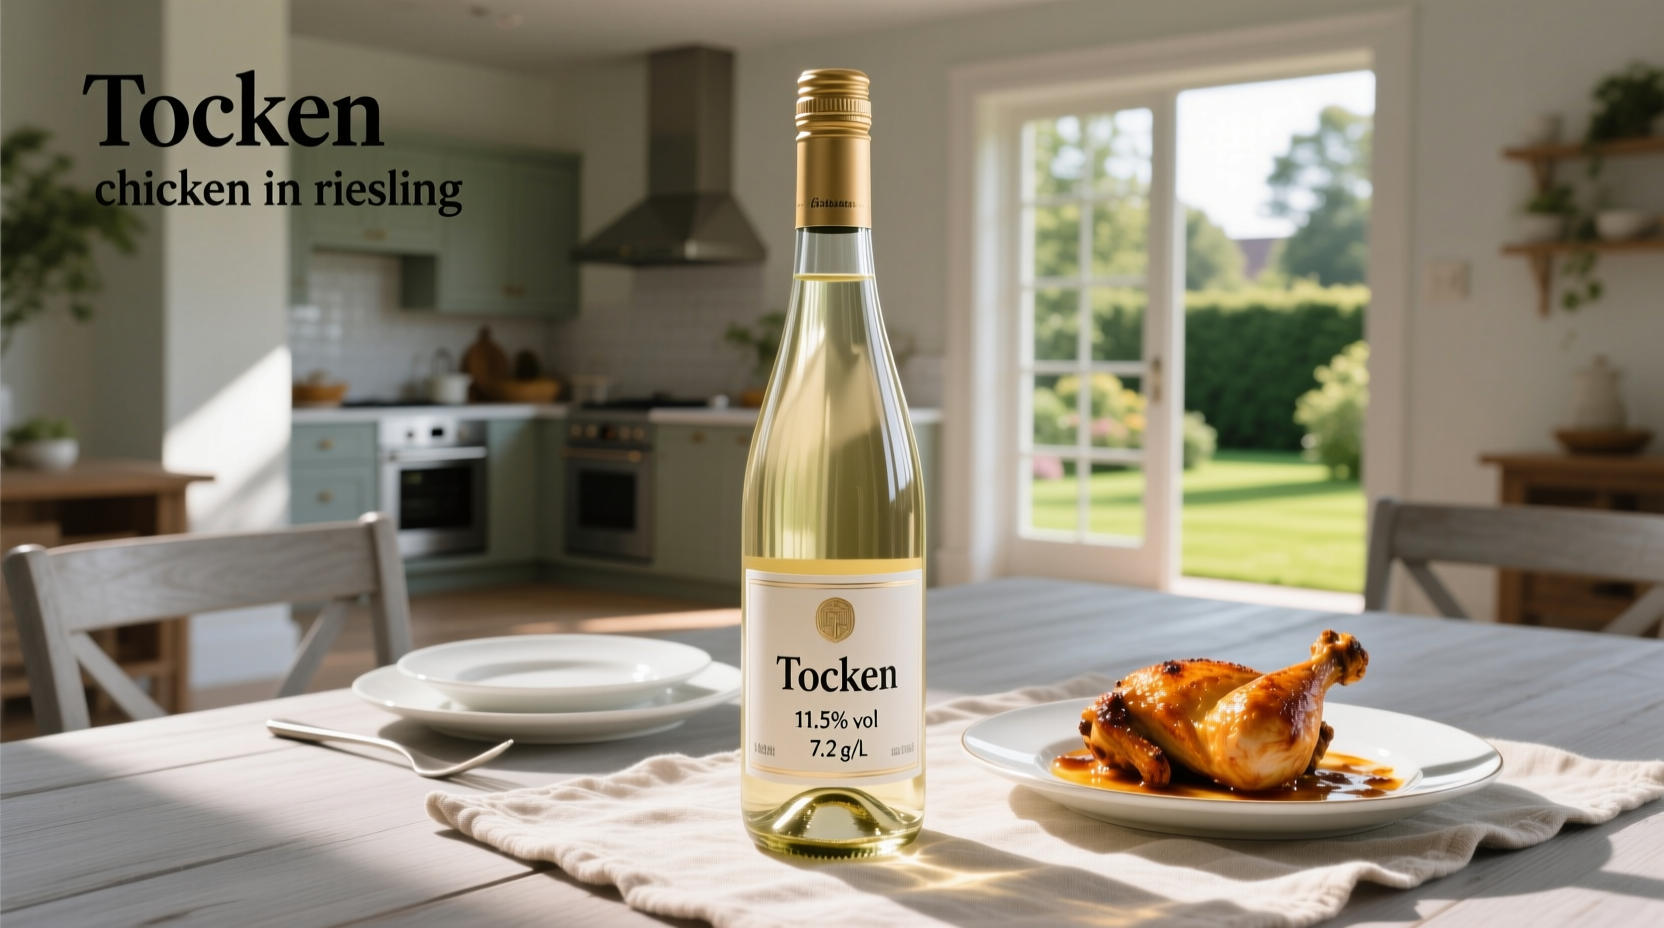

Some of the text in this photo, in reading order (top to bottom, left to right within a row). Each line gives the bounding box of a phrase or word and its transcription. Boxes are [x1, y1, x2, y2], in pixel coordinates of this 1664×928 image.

[776, 655, 898, 693] Tocken
[795, 708, 879, 730] 11.5% vol
[810, 739, 837, 758] 7.2
[840, 738, 868, 763] g/L
